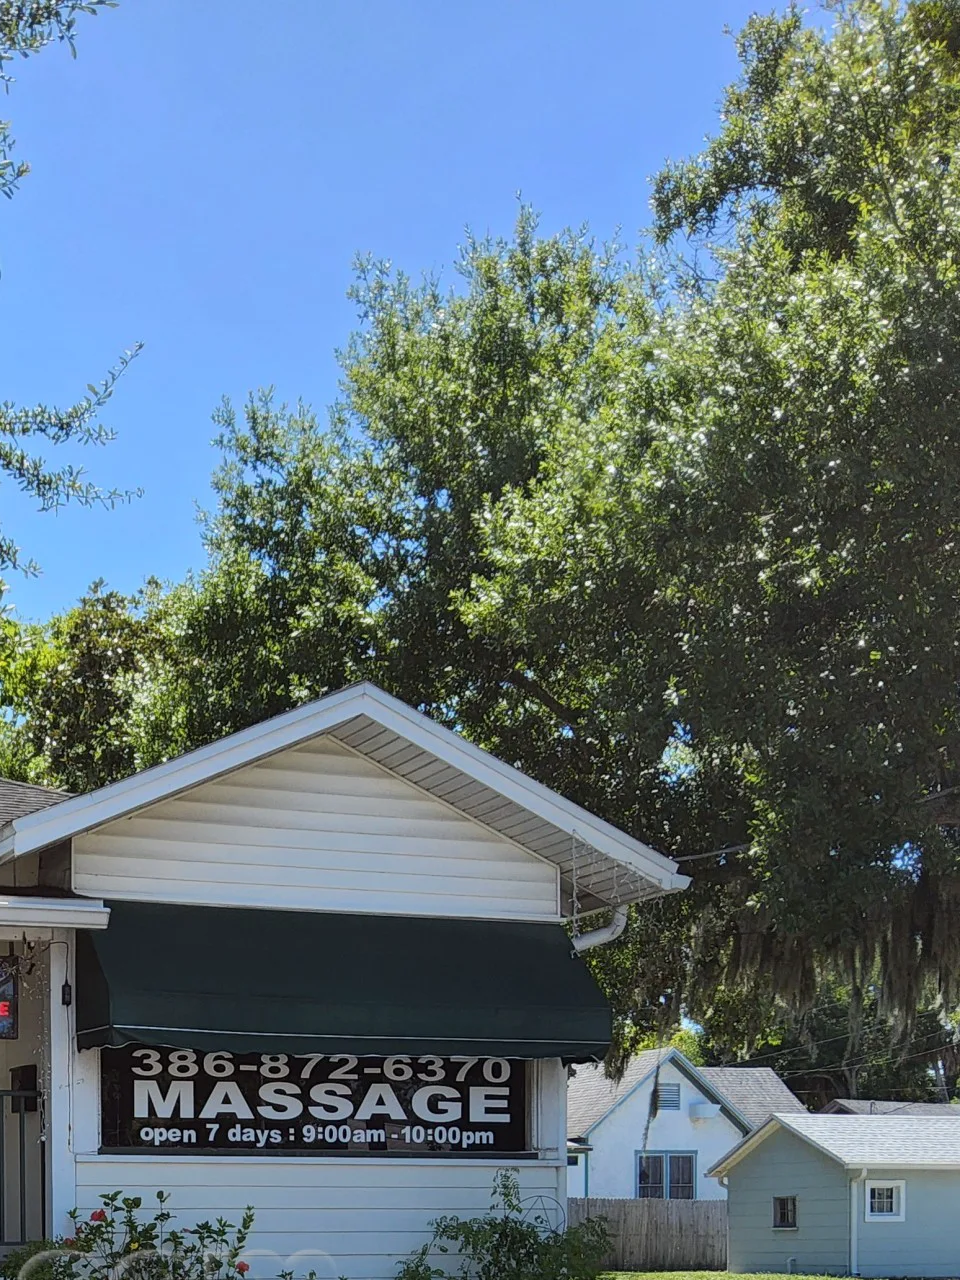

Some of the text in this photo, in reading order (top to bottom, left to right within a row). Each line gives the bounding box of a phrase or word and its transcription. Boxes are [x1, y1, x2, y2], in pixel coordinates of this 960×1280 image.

[131, 1048, 512, 1083] 386-872-6370
[133, 1079, 511, 1123] MASSAGE
[139, 1126, 197, 1146] open
[205, 1123, 220, 1142] 7
[227, 1124, 282, 1148] days
[302, 1125, 386, 1144] 9:00am
